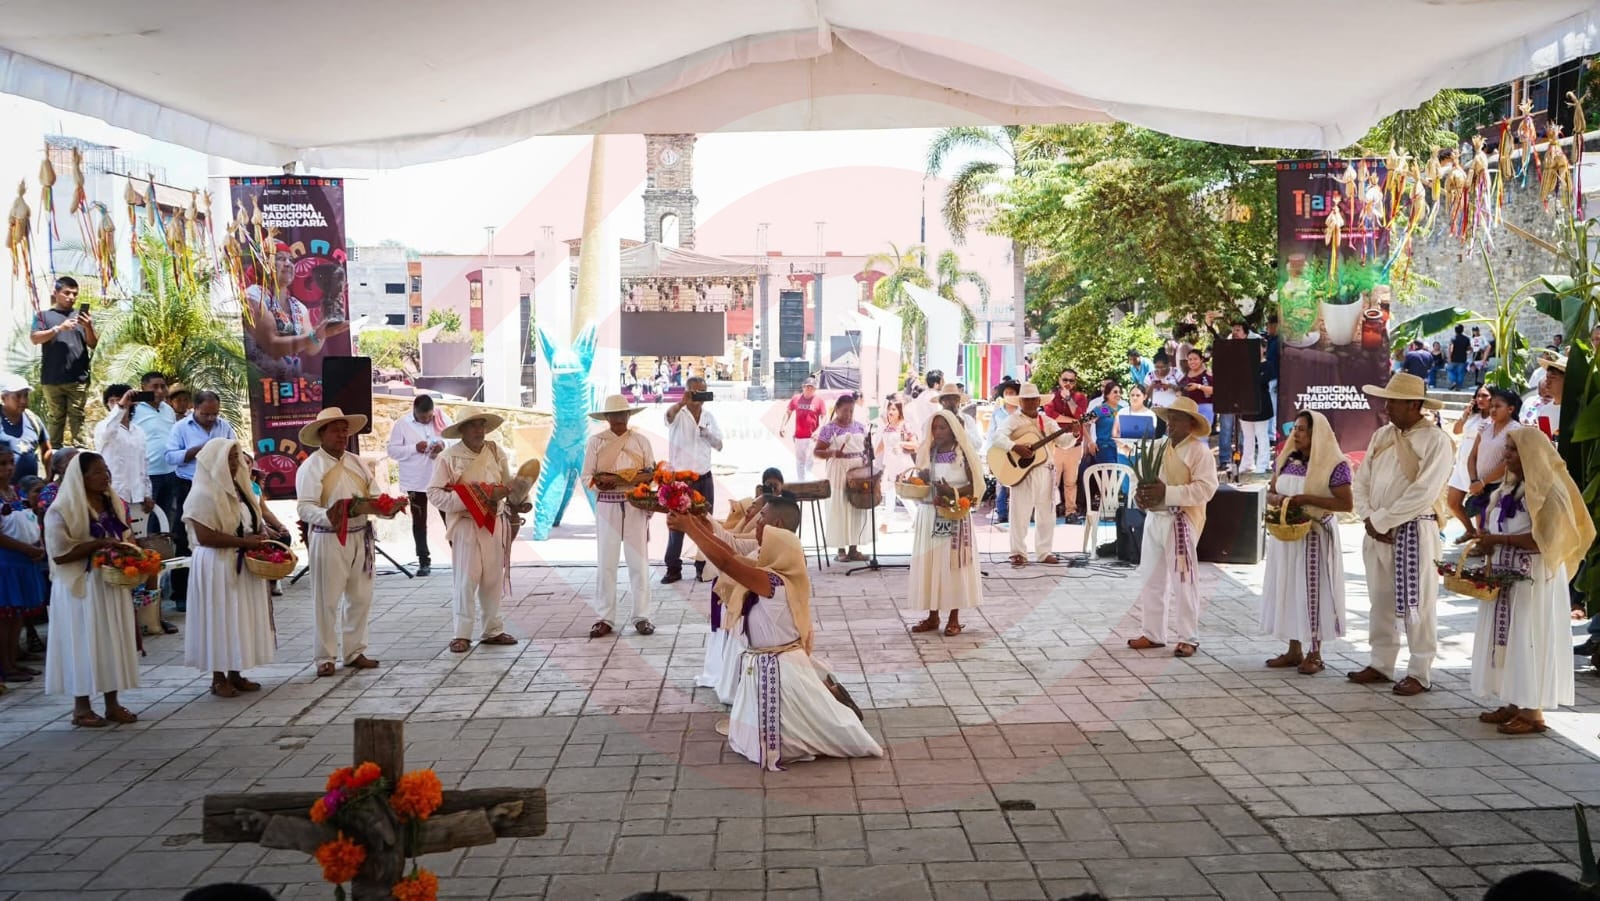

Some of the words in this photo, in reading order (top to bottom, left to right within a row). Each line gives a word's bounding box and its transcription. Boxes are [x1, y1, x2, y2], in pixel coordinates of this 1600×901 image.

[263, 203, 315, 212] MEDICINA
[1292, 190, 1343, 219] Tlaj
[261, 211, 325, 220] RADICIONAL
[262, 219, 329, 228] HERBOLARIA
[1306, 385, 1358, 394] MEDICINA
[1296, 393, 1368, 402] TRADICIONAL
[1294, 401, 1302, 410] Y
[1303, 401, 1371, 410] HERBOLARIA
